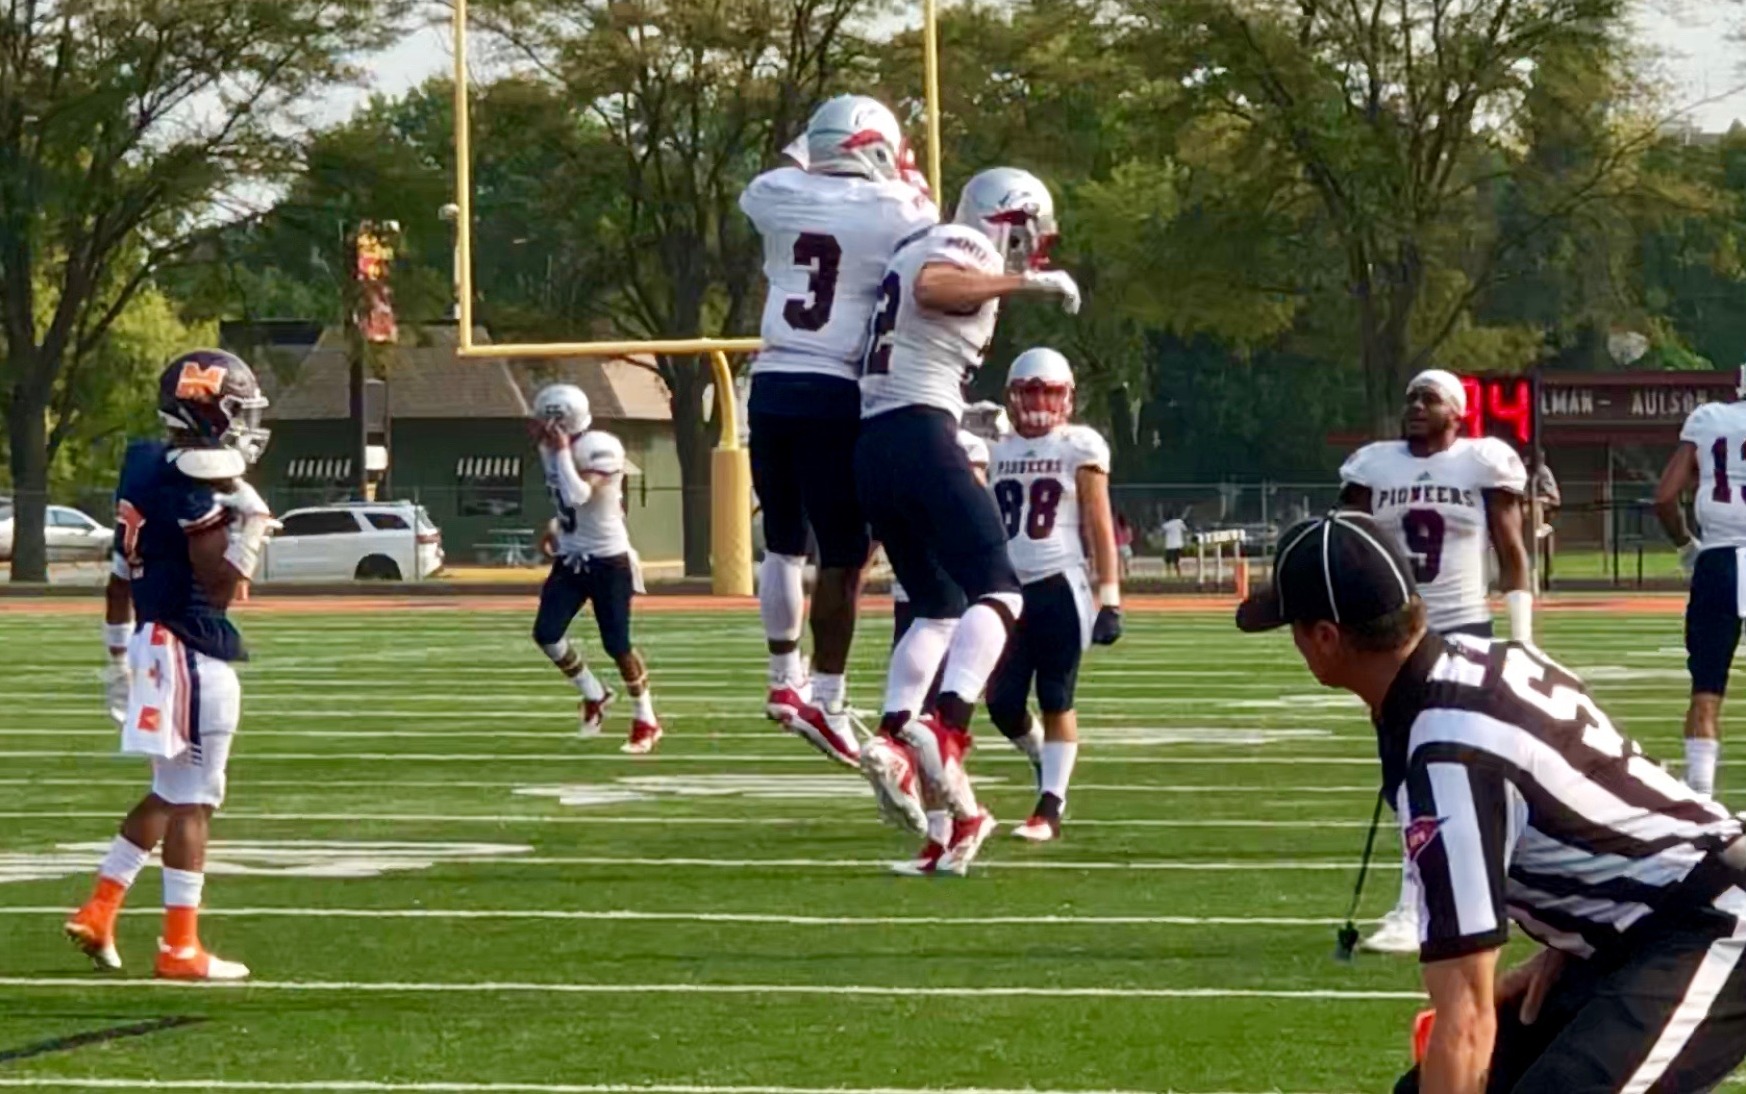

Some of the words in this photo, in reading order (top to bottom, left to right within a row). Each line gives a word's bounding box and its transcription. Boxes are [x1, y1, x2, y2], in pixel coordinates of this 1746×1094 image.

[782, 232, 842, 332] 3
[1377, 484, 1476, 509] PIONEERS
[1711, 437, 1746, 504] 1
[994, 478, 1064, 540] 88
[1402, 509, 1444, 583] 9
